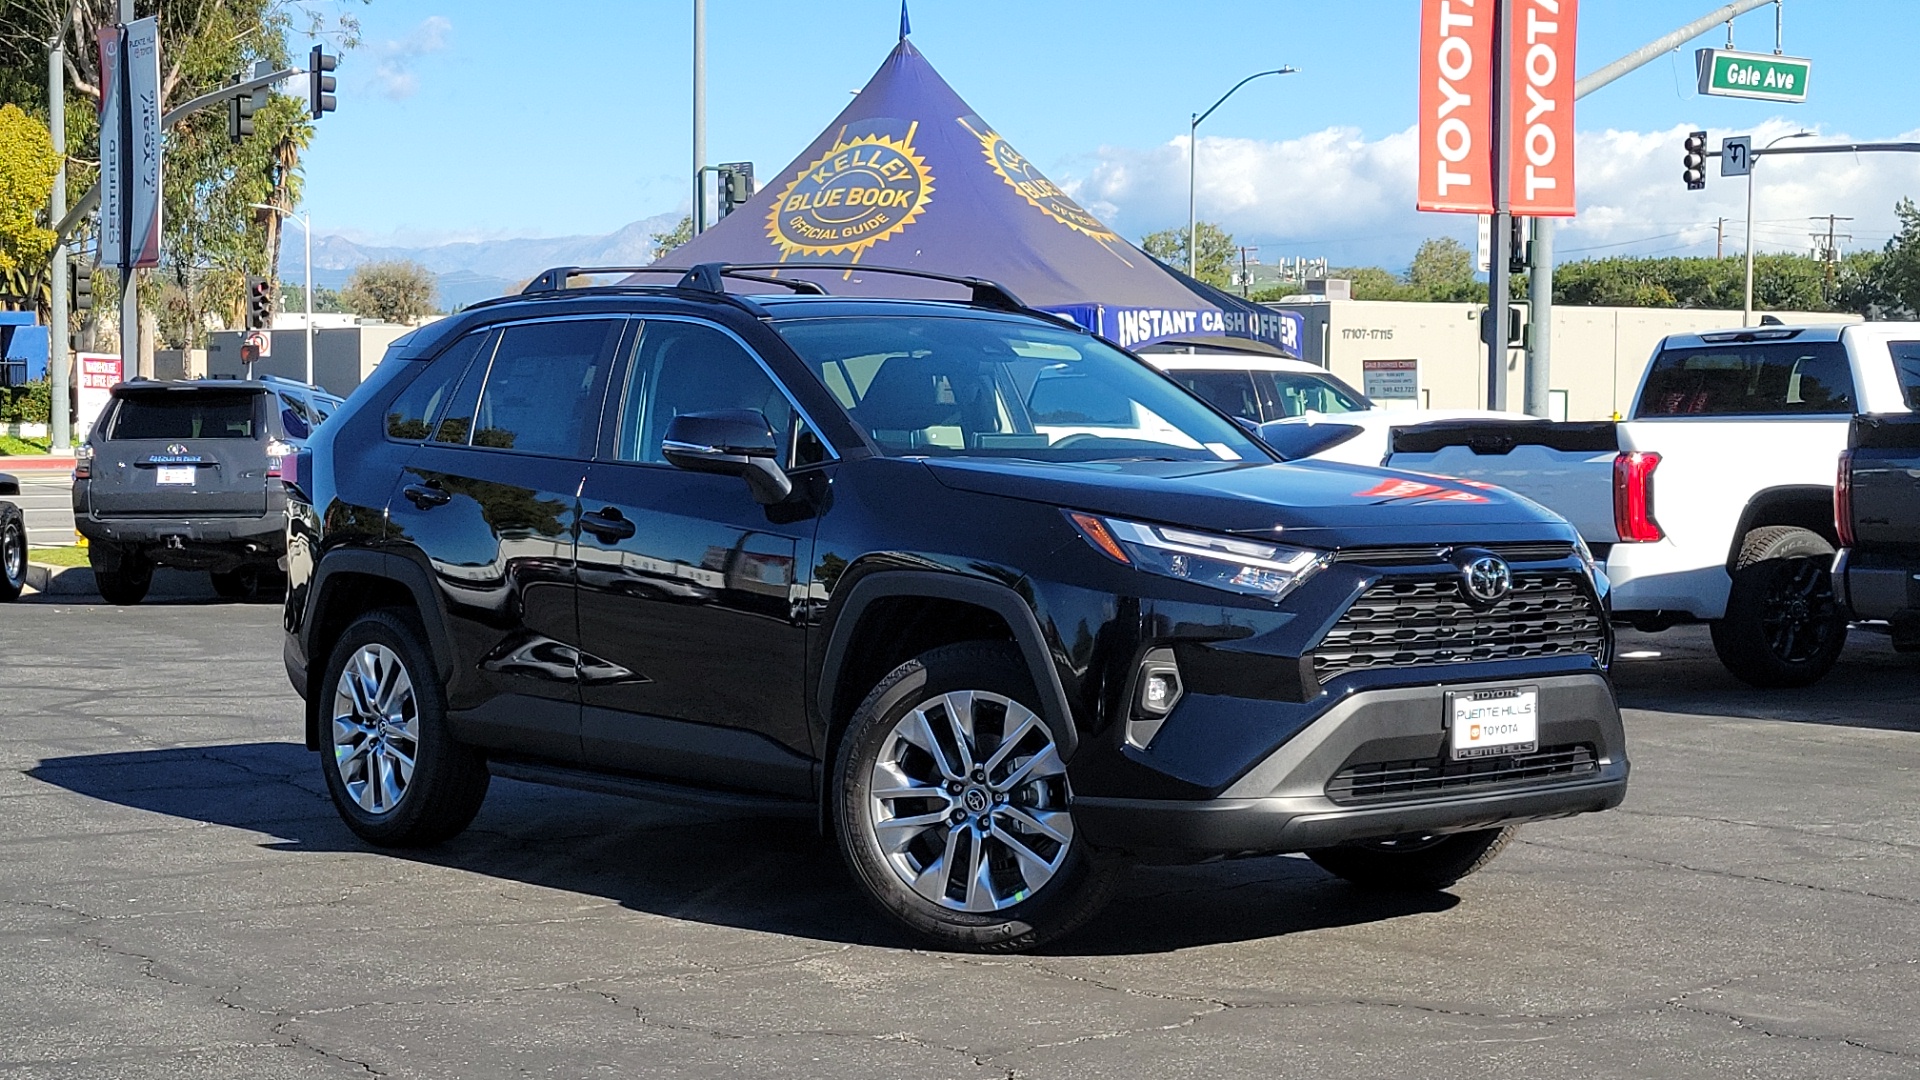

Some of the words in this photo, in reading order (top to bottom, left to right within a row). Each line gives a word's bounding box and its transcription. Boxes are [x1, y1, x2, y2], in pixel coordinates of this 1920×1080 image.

[1727, 63, 1761, 86] Gale
[1763, 67, 1794, 90] Ave
[1437, 0, 1475, 196] TOYOT
[1525, 0, 1559, 200] TOYOT
[140, 93, 151, 164] Year/
[811, 150, 913, 184] KELLEY
[108, 139, 116, 245] CERTIFIED
[143, 176, 150, 189] 7
[784, 187, 846, 212] BLUE
[845, 187, 914, 209] BOOK
[789, 215, 839, 240] OFFICIAL
[842, 212, 890, 238] GUIDE
[1117, 309, 1197, 348] INSTANT
[1201, 311, 1245, 333] CASH
[1249, 311, 1298, 349] OFFER
[1342, 328, 1393, 340] 17107-17115
[1474, 689, 1519, 700] TOYOTA
[1456, 706, 1500, 720] PUENTE
[1501, 703, 1532, 717] HILLS
[1483, 723, 1518, 736] TOYOTA
[1458, 745, 1502, 758] PUENTE
[1502, 742, 1534, 754] HILLS
